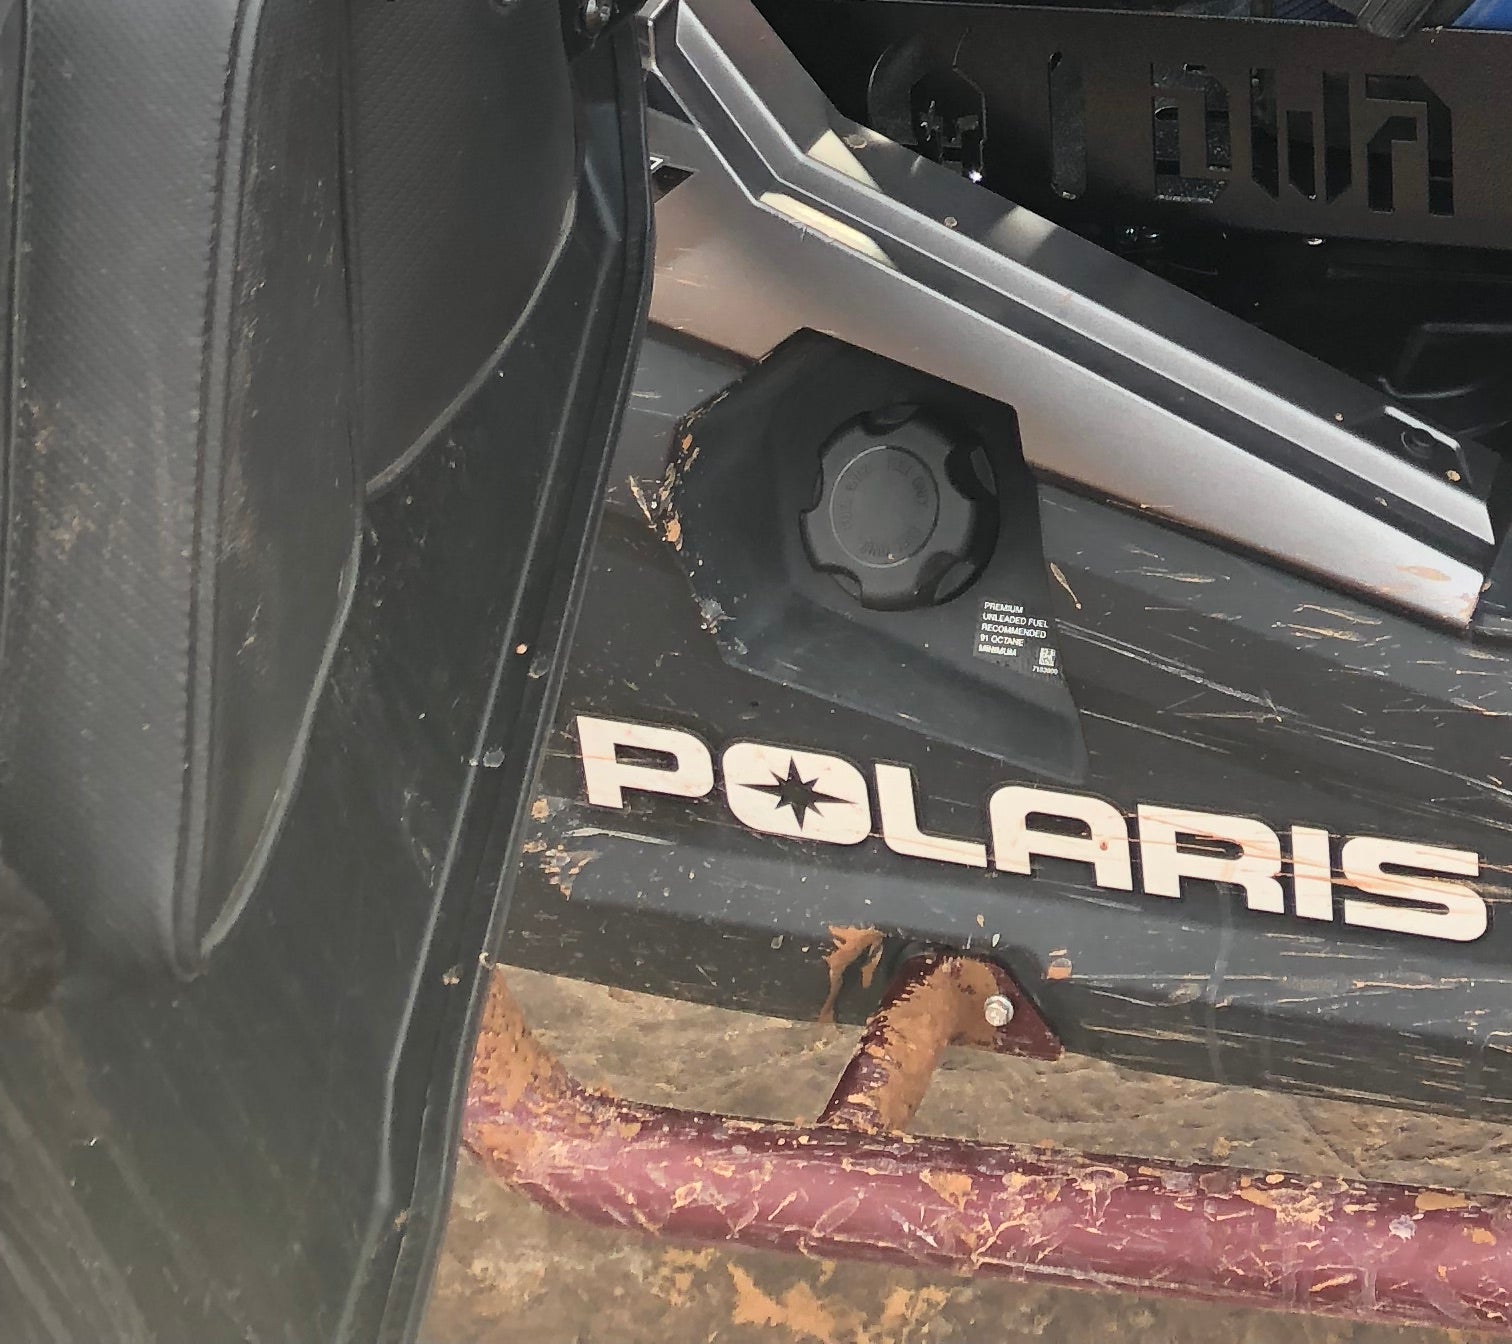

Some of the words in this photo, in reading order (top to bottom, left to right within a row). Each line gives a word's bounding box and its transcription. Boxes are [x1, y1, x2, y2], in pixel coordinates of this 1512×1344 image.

[984, 601, 1024, 614] PREMIUM
[982, 612, 1027, 626] UNLEADED
[1028, 617, 1049, 629] FUEL
[981, 622, 1047, 639] RECOMMENDED
[979, 633, 989, 642] 91
[991, 634, 1025, 647] OCTANE
[576, 714, 1488, 943] POLARIS
